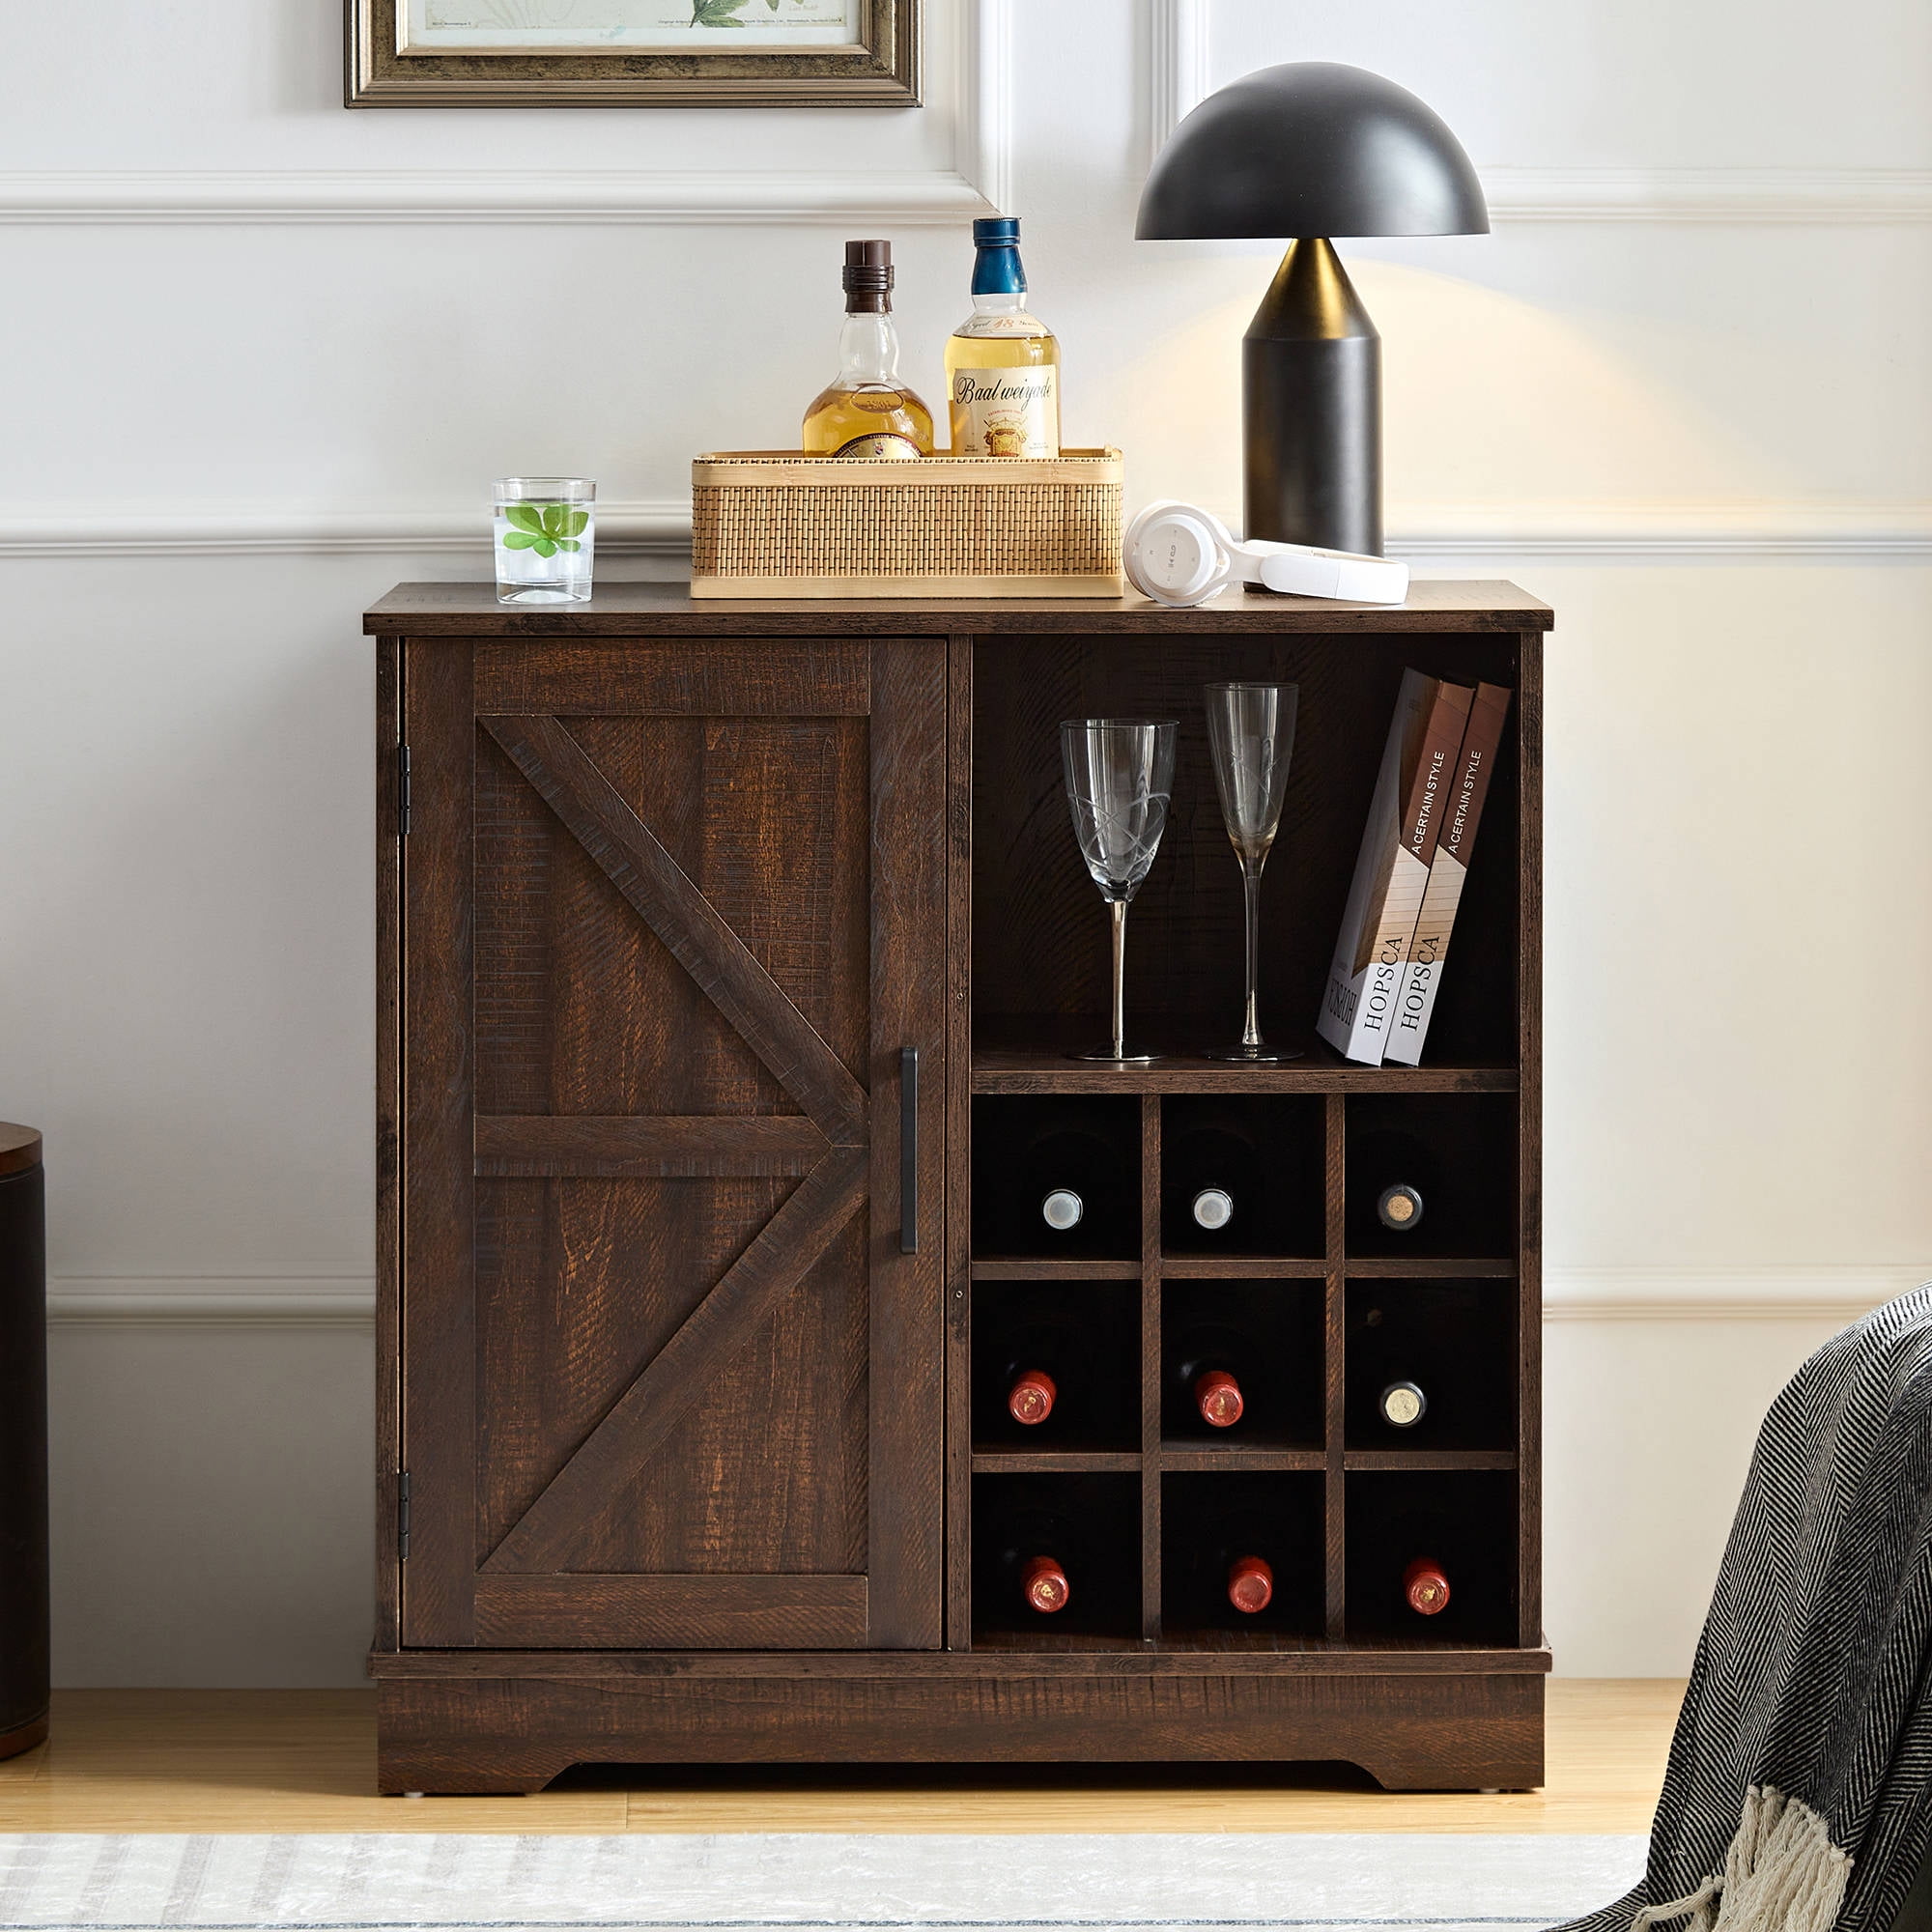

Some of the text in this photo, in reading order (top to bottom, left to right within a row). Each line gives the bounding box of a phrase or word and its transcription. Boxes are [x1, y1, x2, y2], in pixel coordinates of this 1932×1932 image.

[956, 376, 1002, 405] Baal
[1411, 751, 1445, 855] A CERTAIN STYLE
[1448, 750, 1482, 854] A CERTAIN STYLE
[1364, 936, 1404, 1032] HOPSCA
[1400, 936, 1440, 1032] HOPSCA
